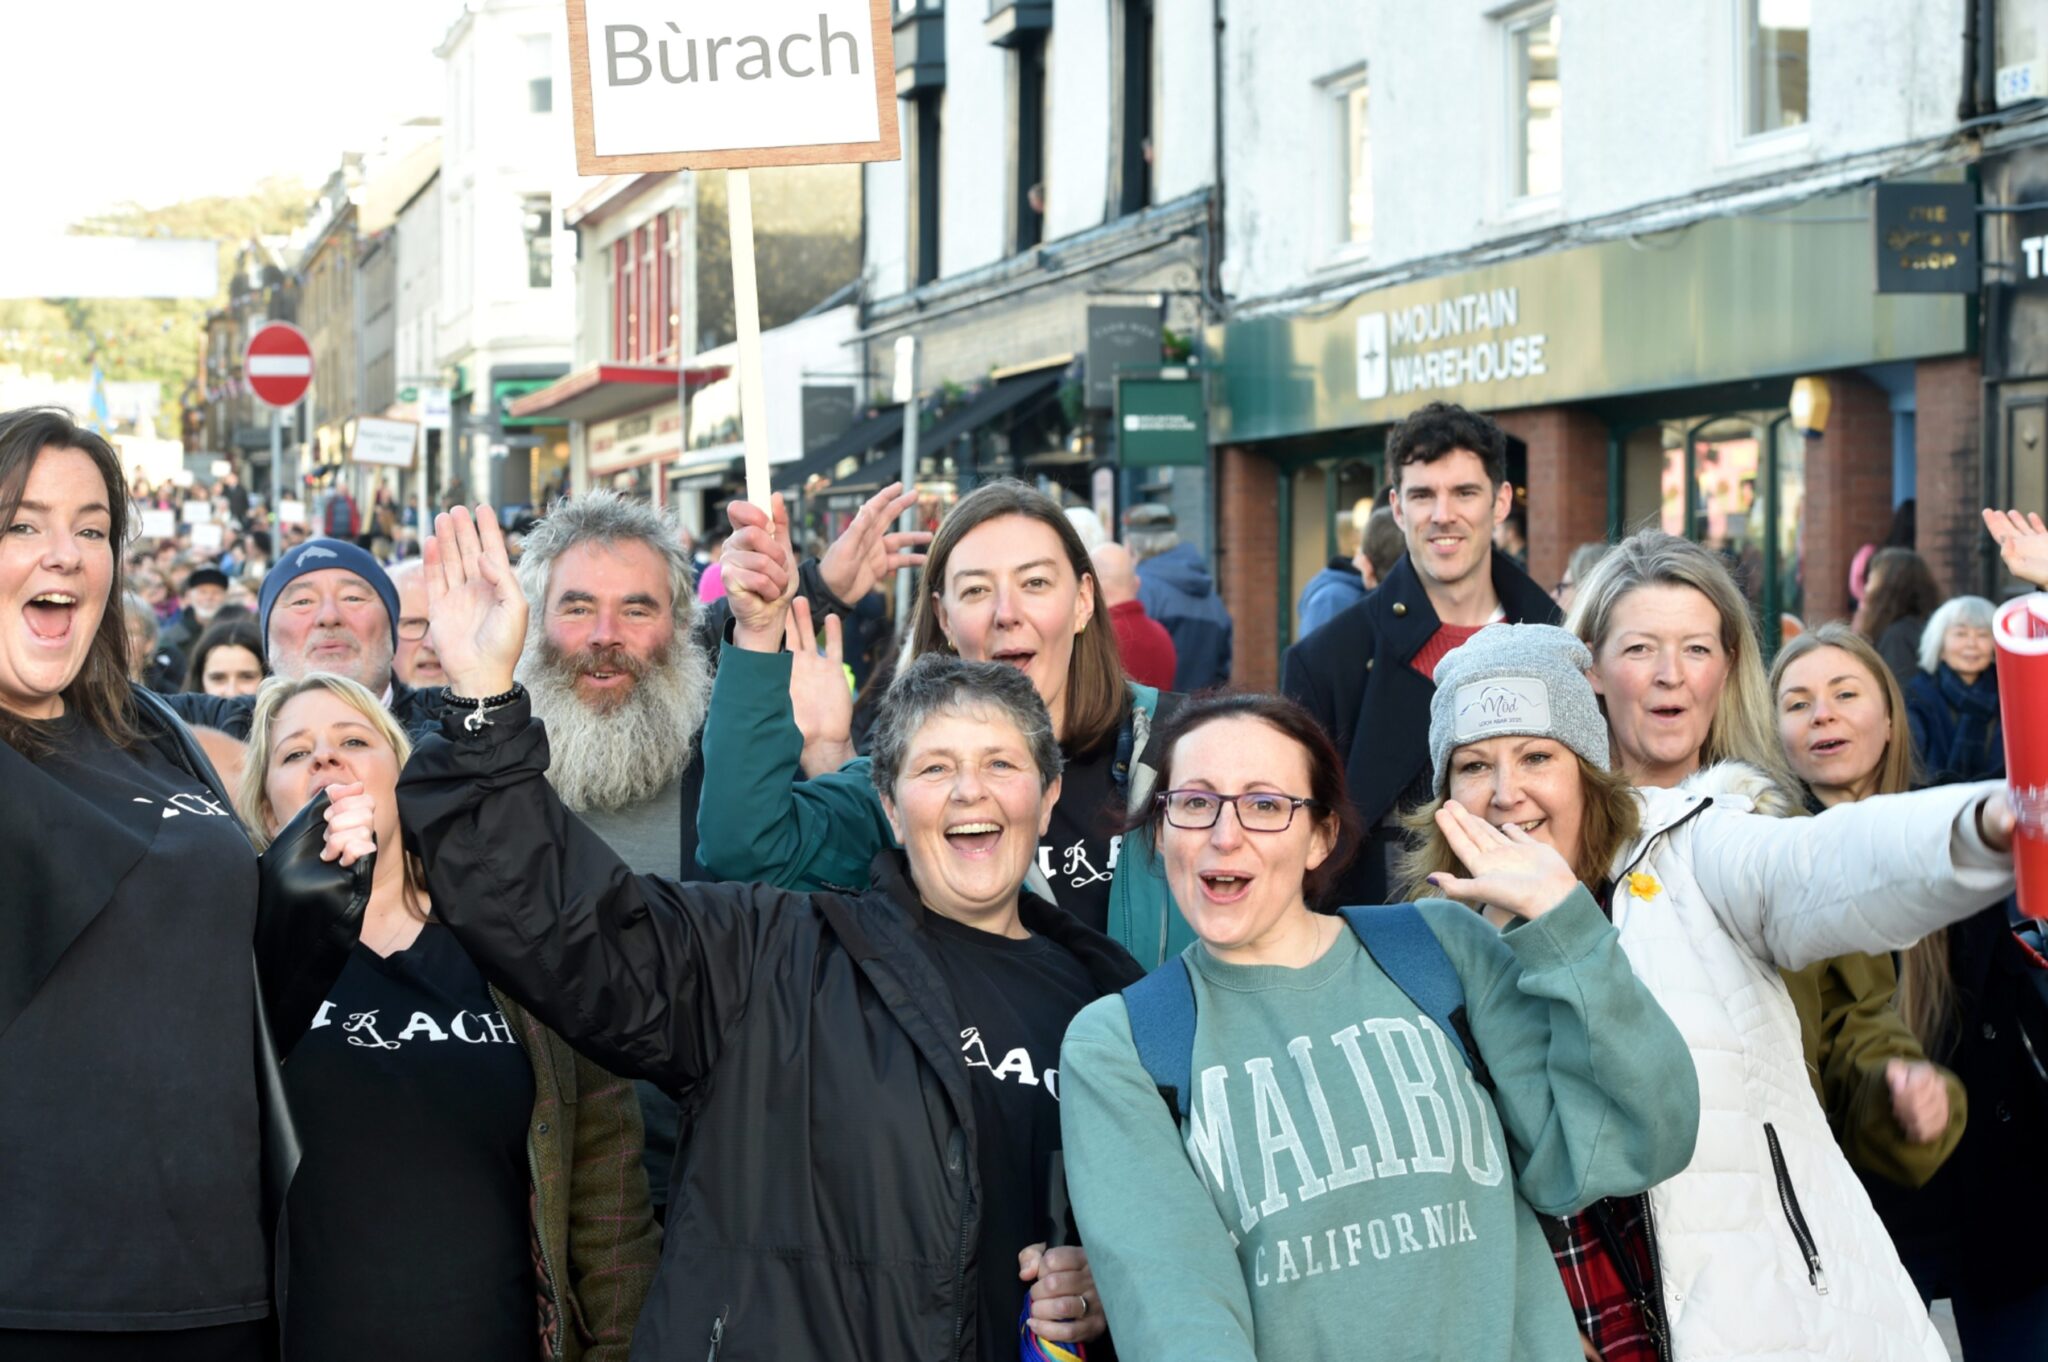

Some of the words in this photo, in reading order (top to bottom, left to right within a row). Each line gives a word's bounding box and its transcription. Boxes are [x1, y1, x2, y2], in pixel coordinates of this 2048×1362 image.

[604, 13, 860, 87] Bùrach
[2021, 234, 2048, 279] T
[1390, 286, 1519, 346] MOUNTAIN
[1390, 333, 1548, 389] WAREHOUSE
[1186, 1014, 1505, 1250] MALIBU
[1254, 1200, 1478, 1288] CALIFORNIA
